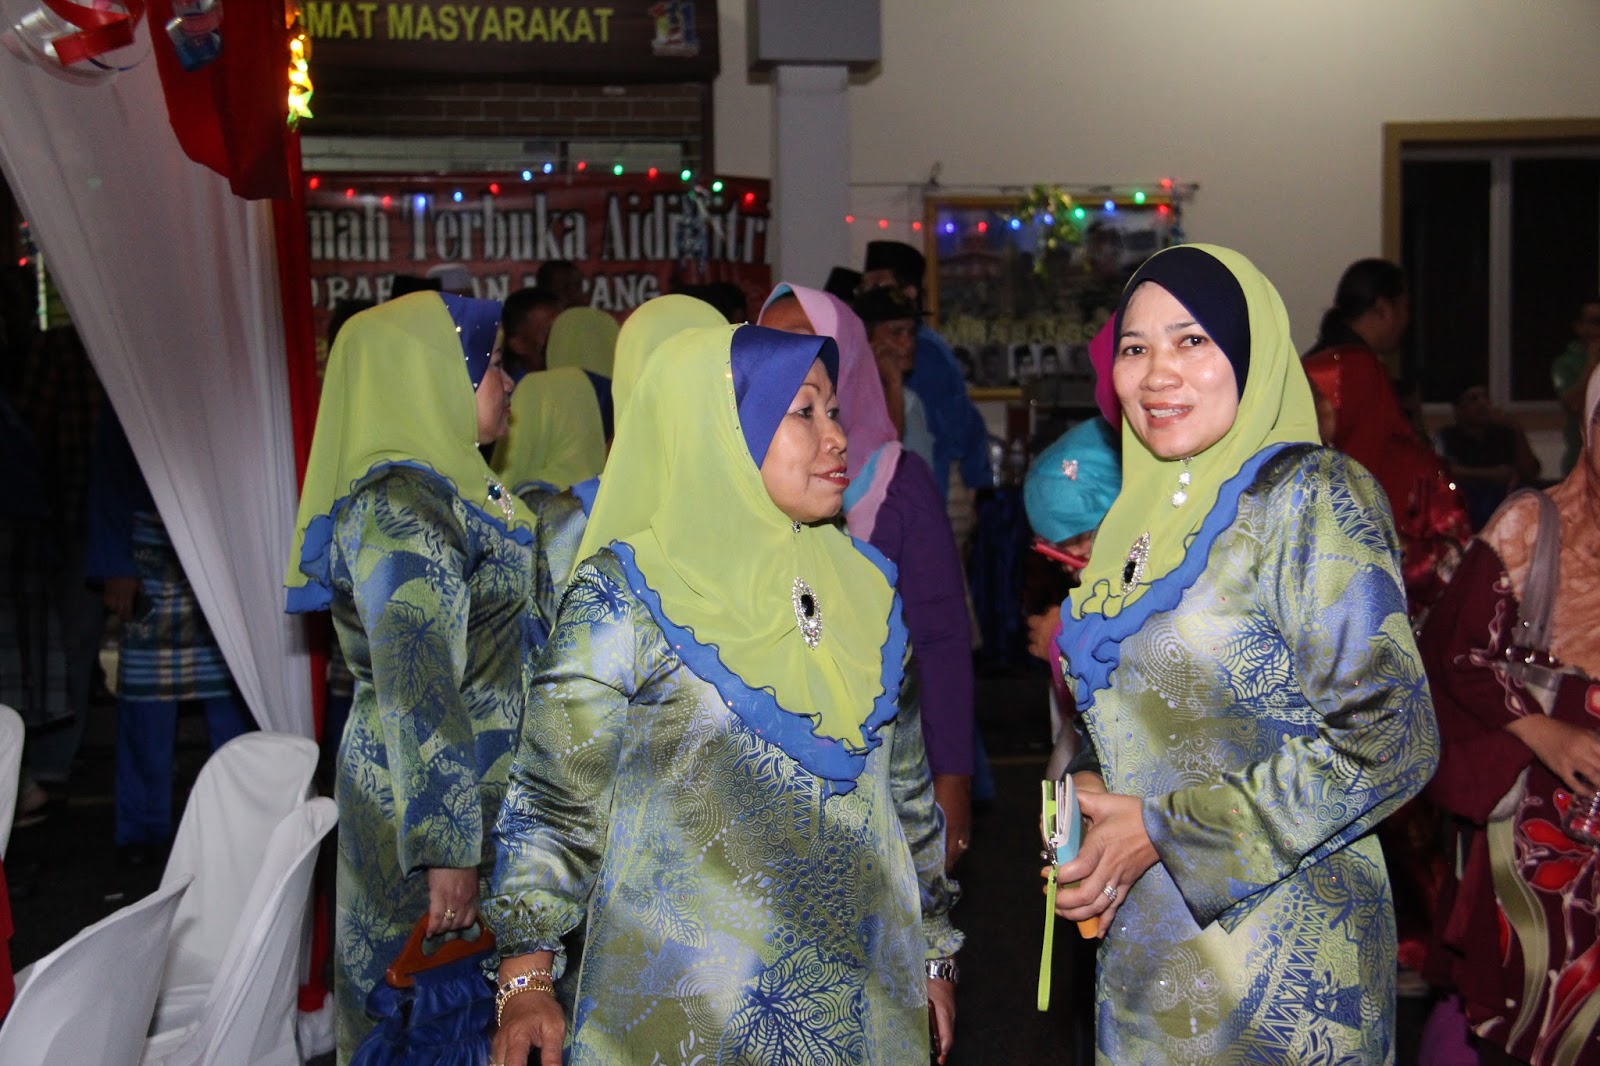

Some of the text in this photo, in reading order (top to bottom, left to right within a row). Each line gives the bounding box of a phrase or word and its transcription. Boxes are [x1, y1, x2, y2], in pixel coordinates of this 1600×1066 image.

[300, 1, 613, 43] MAT MASYARAKAT
[402, 194, 587, 262] Terbuka
